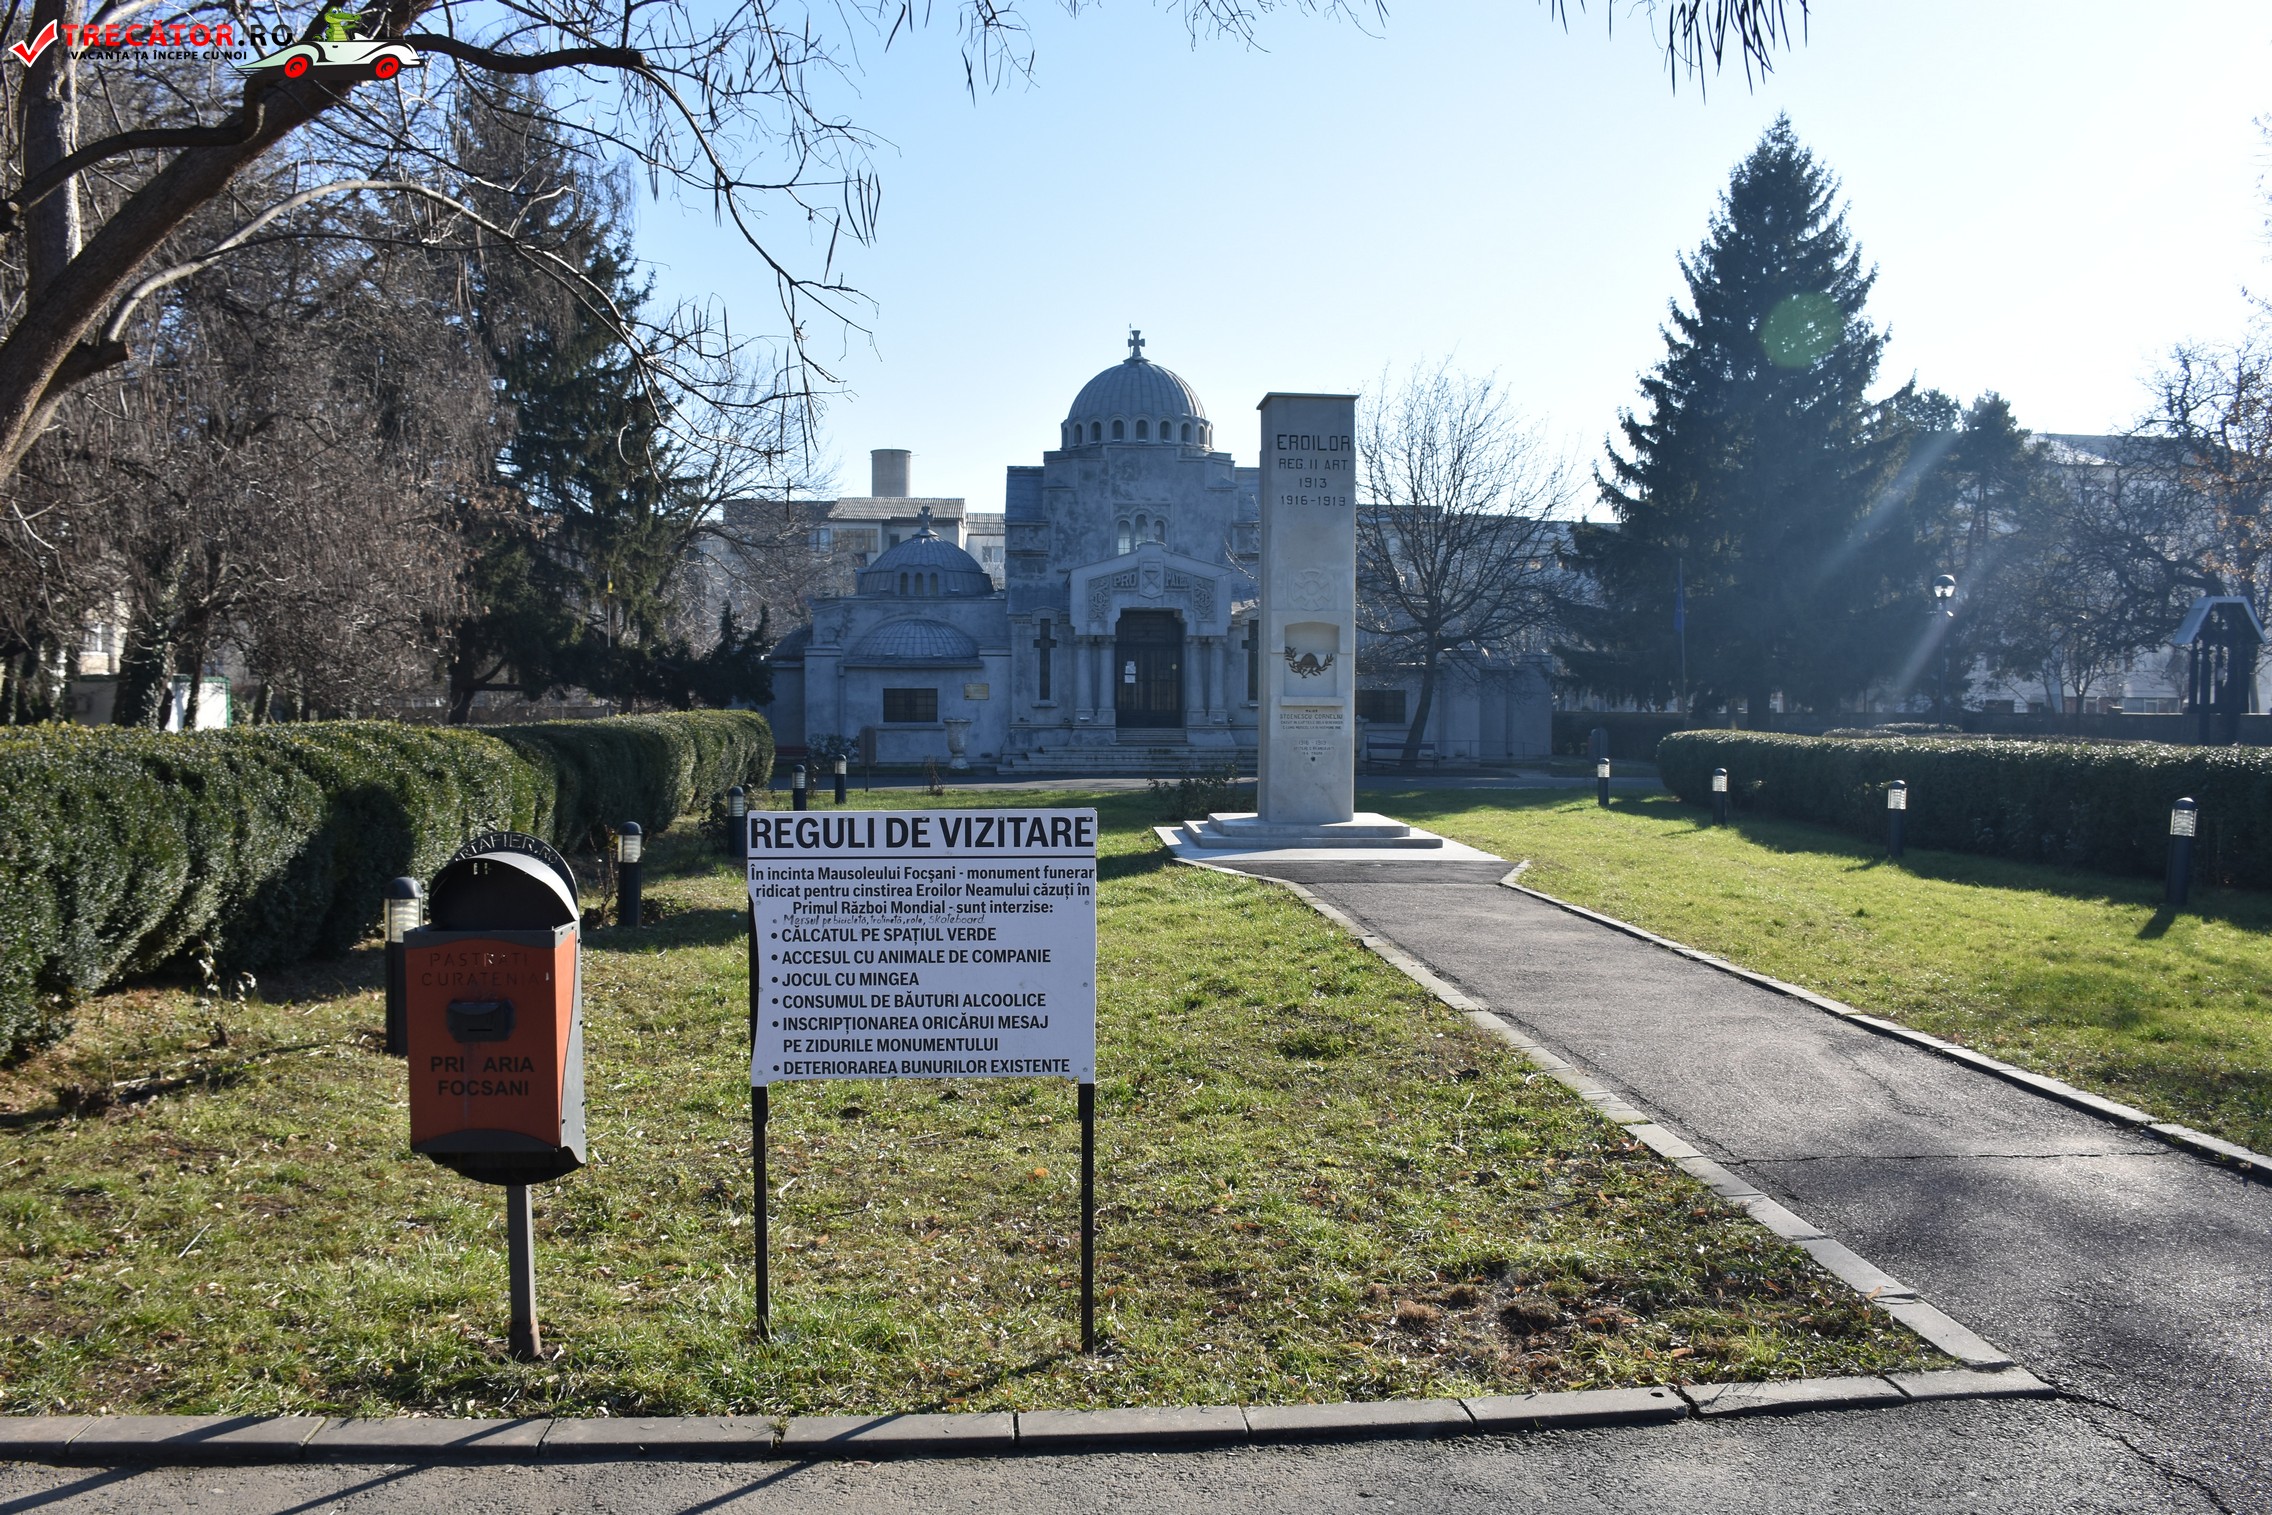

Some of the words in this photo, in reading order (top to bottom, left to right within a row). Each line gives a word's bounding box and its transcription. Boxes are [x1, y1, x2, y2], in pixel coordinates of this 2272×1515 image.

[1277, 434, 1350, 451] EROILOR
[1299, 477, 1327, 488] 1913
[1112, 572, 1137, 587] PRO
[750, 817, 875, 849] REGULI
[886, 817, 931, 849] DE
[938, 816, 1094, 848] VIZITARE
[455, 833, 558, 865] RTAFIER.RO
[751, 864, 764, 880] În
[767, 866, 815, 880] incinta
[818, 866, 901, 880] Mausoleului
[967, 867, 1041, 880] monument
[1043, 865, 1095, 879] funerar
[755, 884, 801, 898] ridicat
[804, 885, 850, 900] pentru
[853, 883, 913, 897] cinstirea
[916, 883, 962, 897] Eroilor
[965, 883, 1030, 897] Neamului
[1077, 882, 1090, 896] în
[793, 901, 838, 915] Primul
[842, 901, 887, 915] Război
[891, 900, 946, 914] Mondial
[956, 902, 987, 914] sunt
[989, 900, 1054, 913] interzise:
[823, 917, 832, 928] pe
[782, 925, 859, 943] CĂLCATUL
[861, 928, 881, 942] PE
[883, 927, 945, 946] SPAȚIUL
[949, 928, 997, 942] VERDE
[782, 951, 851, 965] ACCESUL
[853, 951, 875, 965] CU
[878, 950, 946, 964] ANIMALE
[949, 950, 969, 964] DE
[971, 949, 1051, 964] COMPANIE
[782, 972, 832, 987] JOCUL
[835, 972, 856, 987] CU
[860, 972, 919, 986] MINGEA
[783, 995, 868, 1009] CONSUMUL
[871, 995, 891, 1009] DE
[894, 991, 959, 1008] BĂUTURI
[962, 994, 1047, 1008] ALCOOLICE
[783, 1016, 919, 1035] INSCRIPȚIONAREA
[922, 1012, 994, 1031] ORICĂRUI
[998, 1016, 1049, 1030] MESAJ
[784, 1039, 802, 1053] PE
[805, 1039, 873, 1053] ZIDURILE
[877, 1038, 999, 1053] MONUMENTULUI
[784, 1060, 899, 1075] DETERIORAREA
[902, 1060, 988, 1074] BUNURILOR
[991, 1059, 1071, 1074] EXISTENTE
[437, 1080, 529, 1097] FOCSANI
